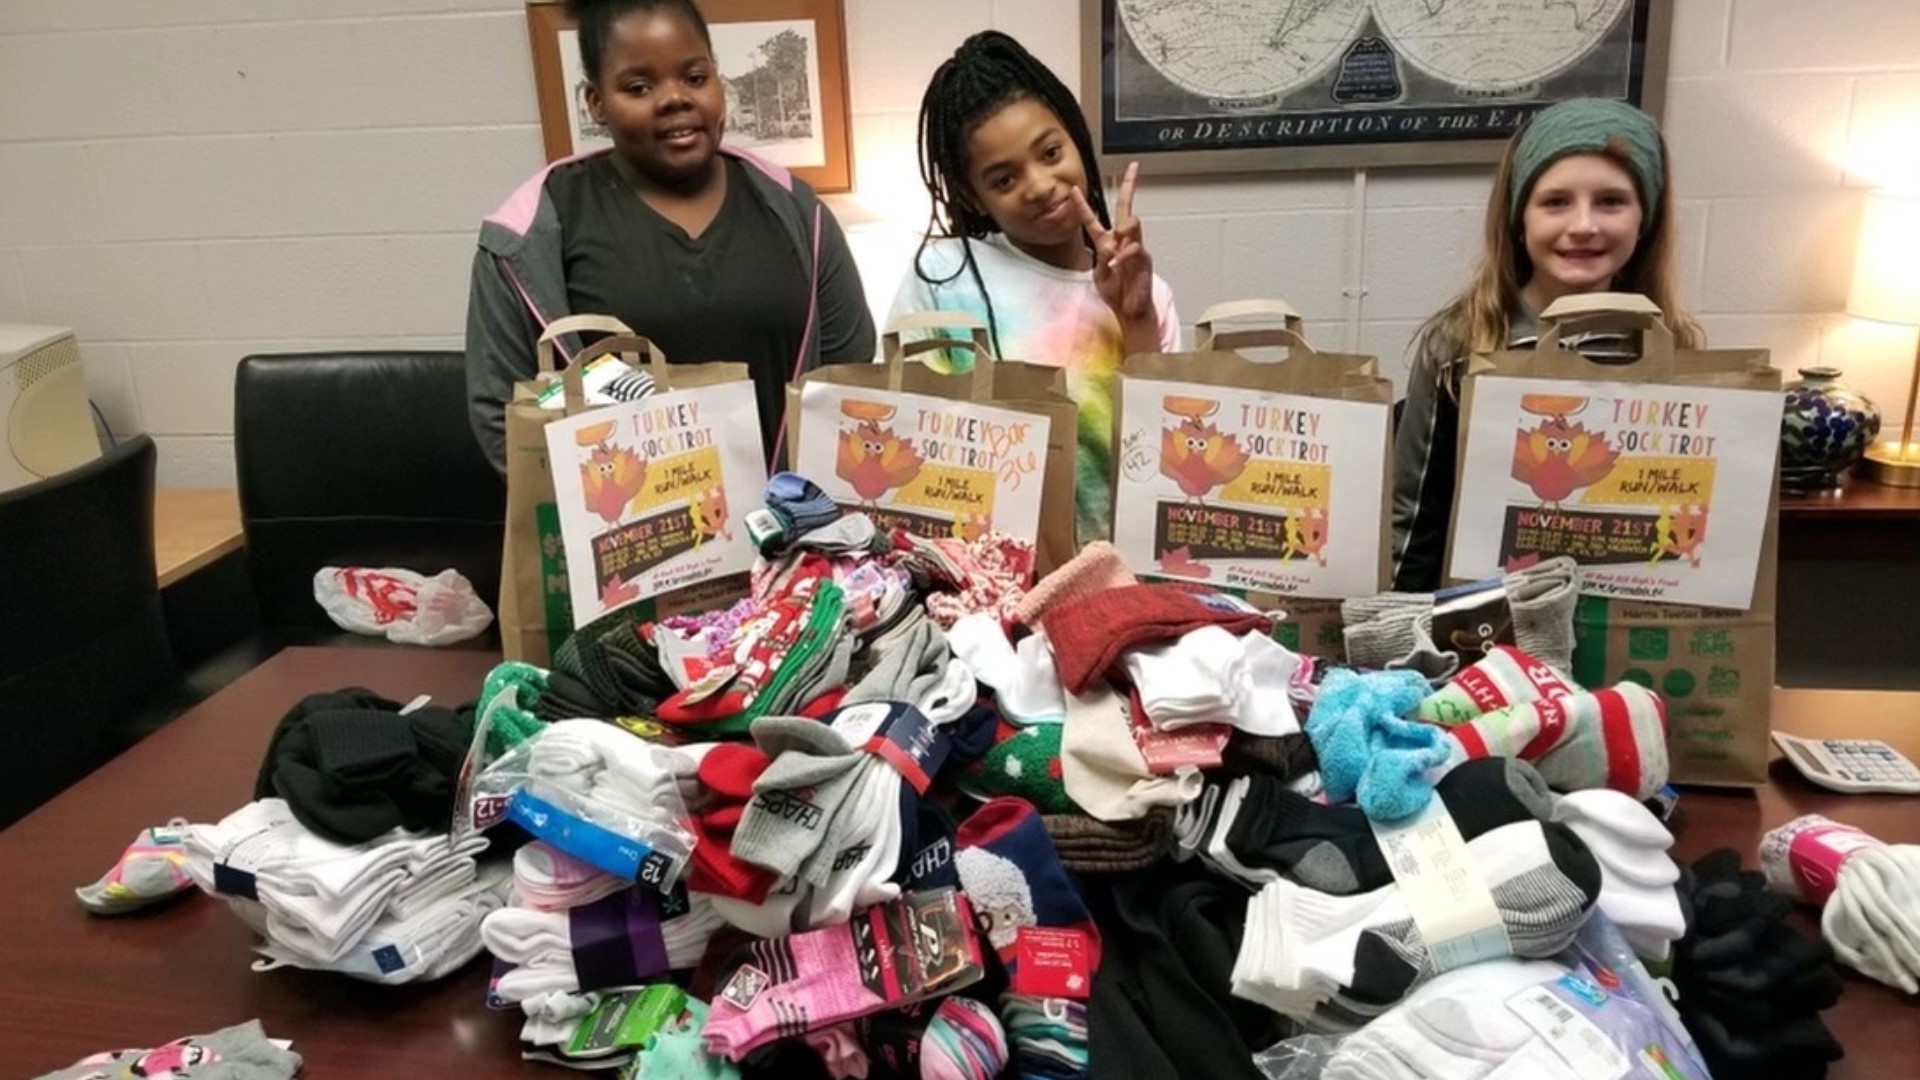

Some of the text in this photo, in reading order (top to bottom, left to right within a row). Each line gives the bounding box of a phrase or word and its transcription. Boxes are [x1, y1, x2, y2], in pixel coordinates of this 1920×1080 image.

[1193, 116, 1392, 139] DESCRIPTION
[1400, 116, 1428, 130] OF
[1438, 114, 1479, 129] THE
[632, 402, 699, 437] TURKEY
[918, 410, 992, 444] TURKEY
[1240, 404, 1321, 436] TURKEY
[1612, 399, 1711, 429] TURKEY
[642, 428, 714, 458] SOCK TROT
[922, 438, 997, 470] SOCK TROT
[1247, 435, 1329, 463] SOCK TROT
[1616, 430, 1716, 457] SOCK TROT
[655, 469, 712, 494] RUN/WALK
[1274, 473, 1301, 486] MILE
[1619, 479, 1699, 495] RUN/WALK
[1646, 469, 1682, 481] MILE
[1251, 482, 1319, 499] RUN/WALK
[919, 521, 949, 539] 21ST
[1167, 506, 1281, 536] NOVEMBER 21ST
[1517, 511, 1653, 537] NOVEMBER 21ST
[641, 861, 661, 885] 12
